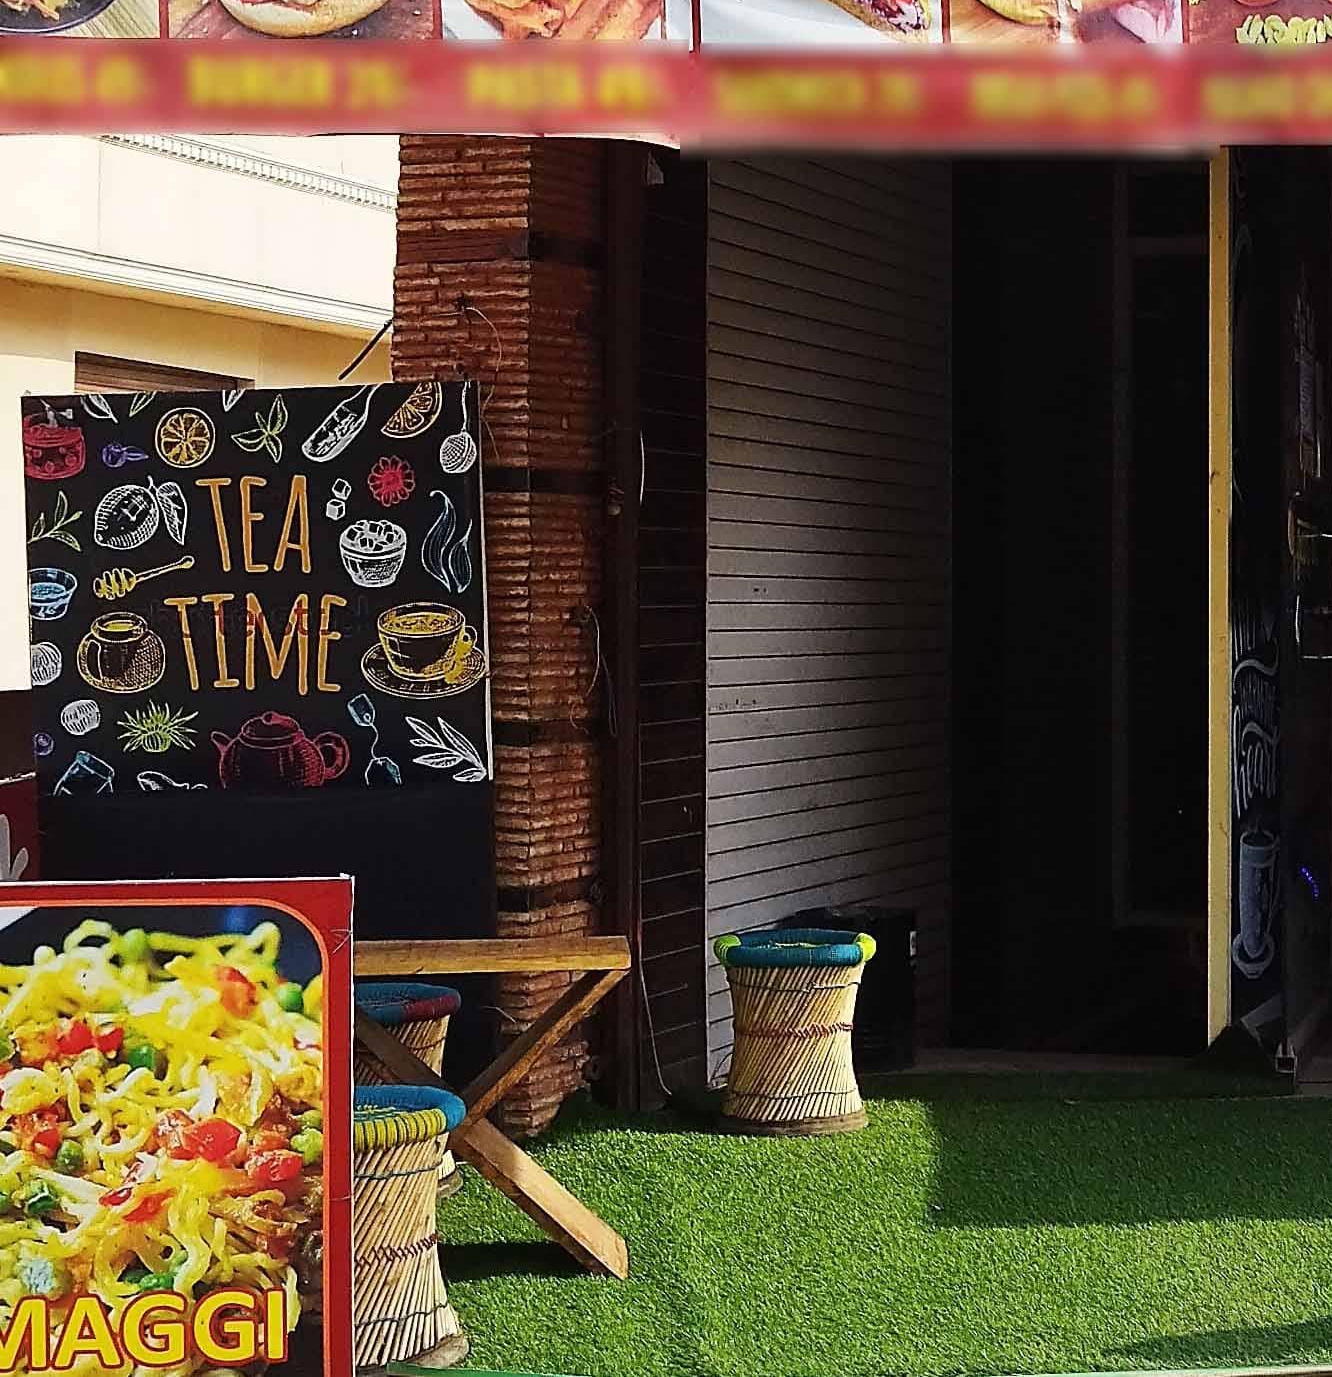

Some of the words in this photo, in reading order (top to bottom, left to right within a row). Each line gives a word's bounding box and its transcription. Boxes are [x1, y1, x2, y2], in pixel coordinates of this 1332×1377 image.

[195, 474, 312, 574] TEA
[163, 592, 347, 696] TIME
[0, 1284, 287, 1372] MAGGI
